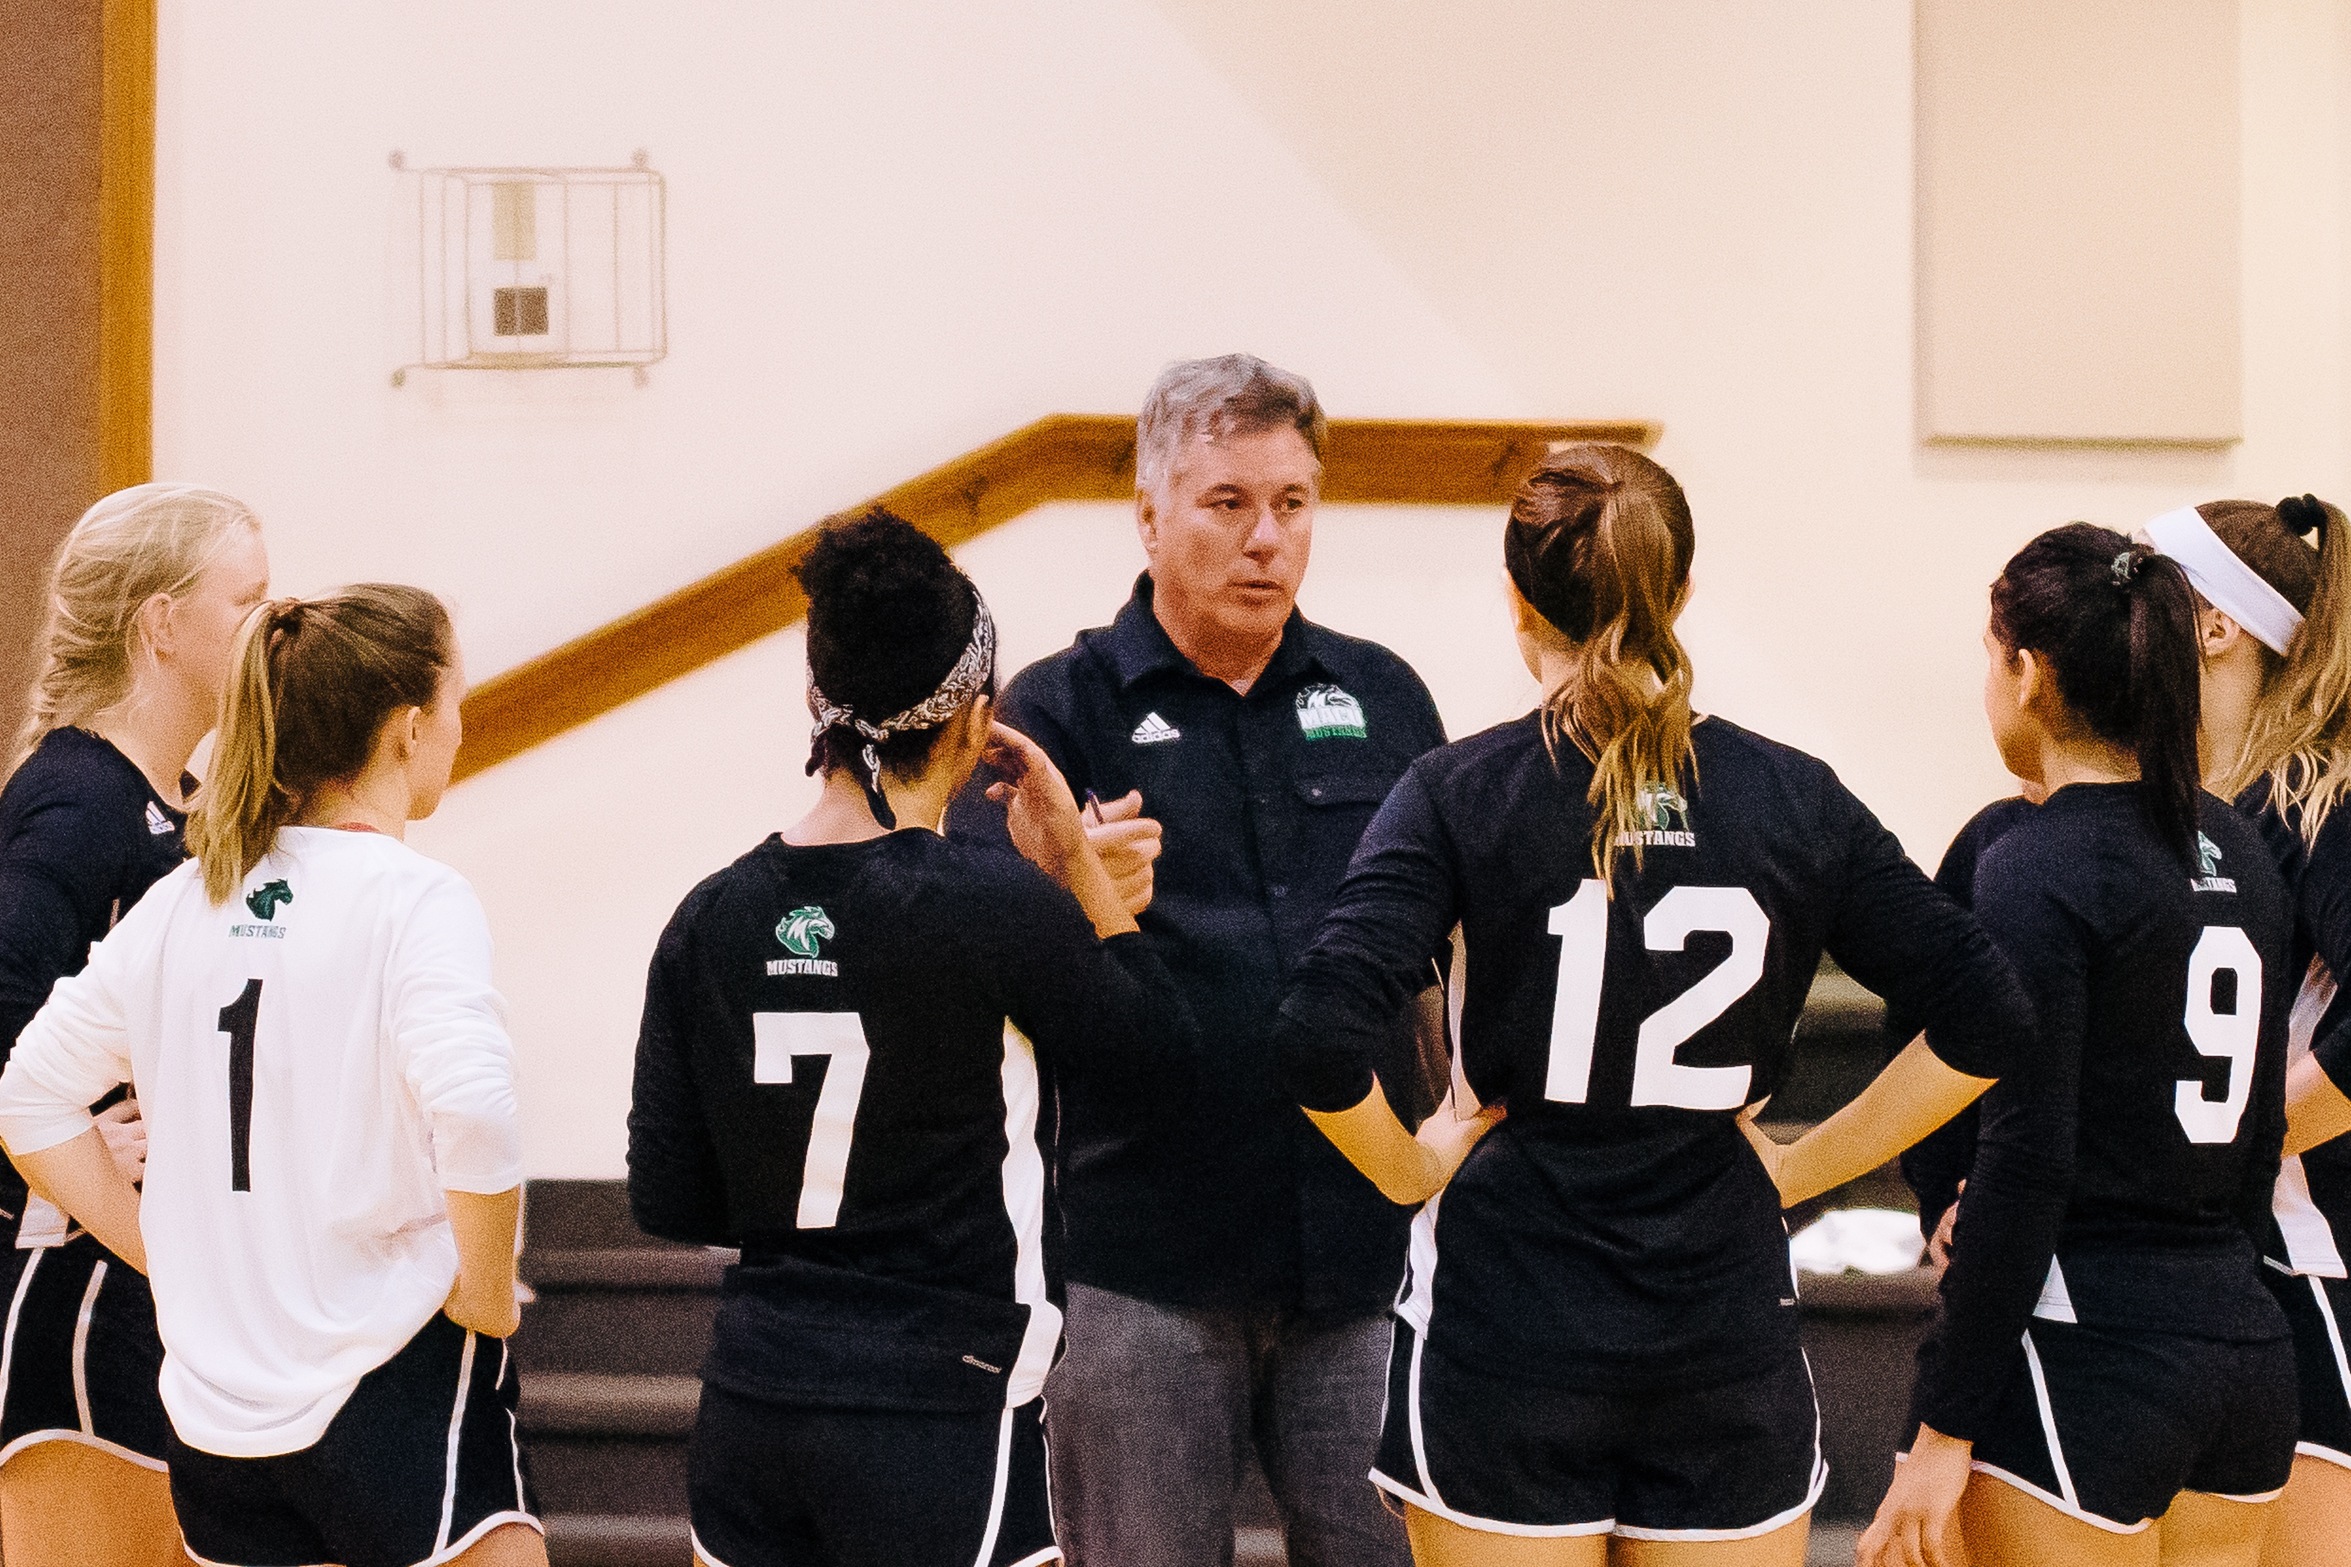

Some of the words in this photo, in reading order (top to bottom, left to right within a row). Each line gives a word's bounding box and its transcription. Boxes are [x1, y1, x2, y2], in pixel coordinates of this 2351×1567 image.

[1131, 728, 1181, 744] adidas
[765, 958, 839, 977] MUSTANGS
[1544, 878, 1771, 1111] 12
[2174, 925, 2263, 1144] 9
[217, 978, 264, 1193] 1
[753, 1011, 871, 1230] 7
